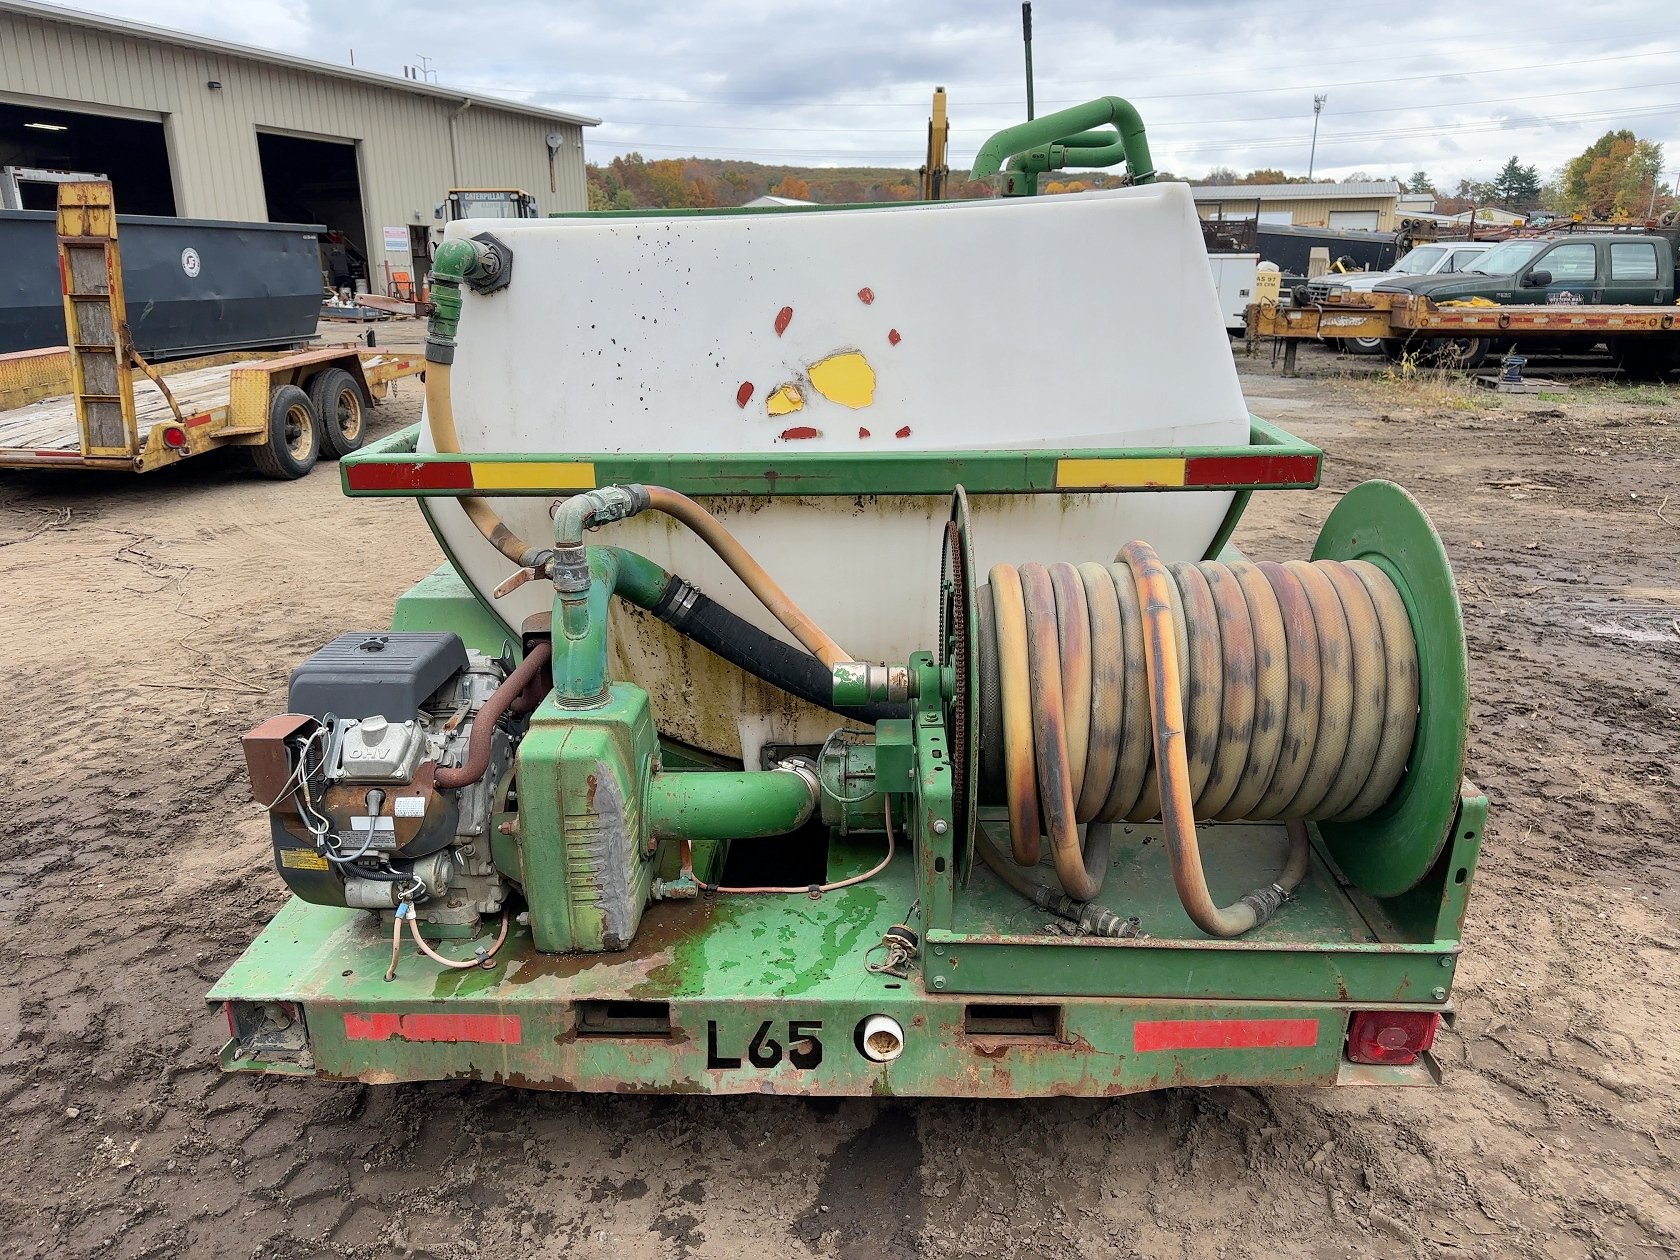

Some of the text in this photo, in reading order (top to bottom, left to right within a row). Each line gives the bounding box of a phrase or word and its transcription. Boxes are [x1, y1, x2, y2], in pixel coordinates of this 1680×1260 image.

[465, 192, 505, 200] CATERPILLAR
[349, 748, 391, 760] OHV
[707, 1020, 823, 1071] L65
